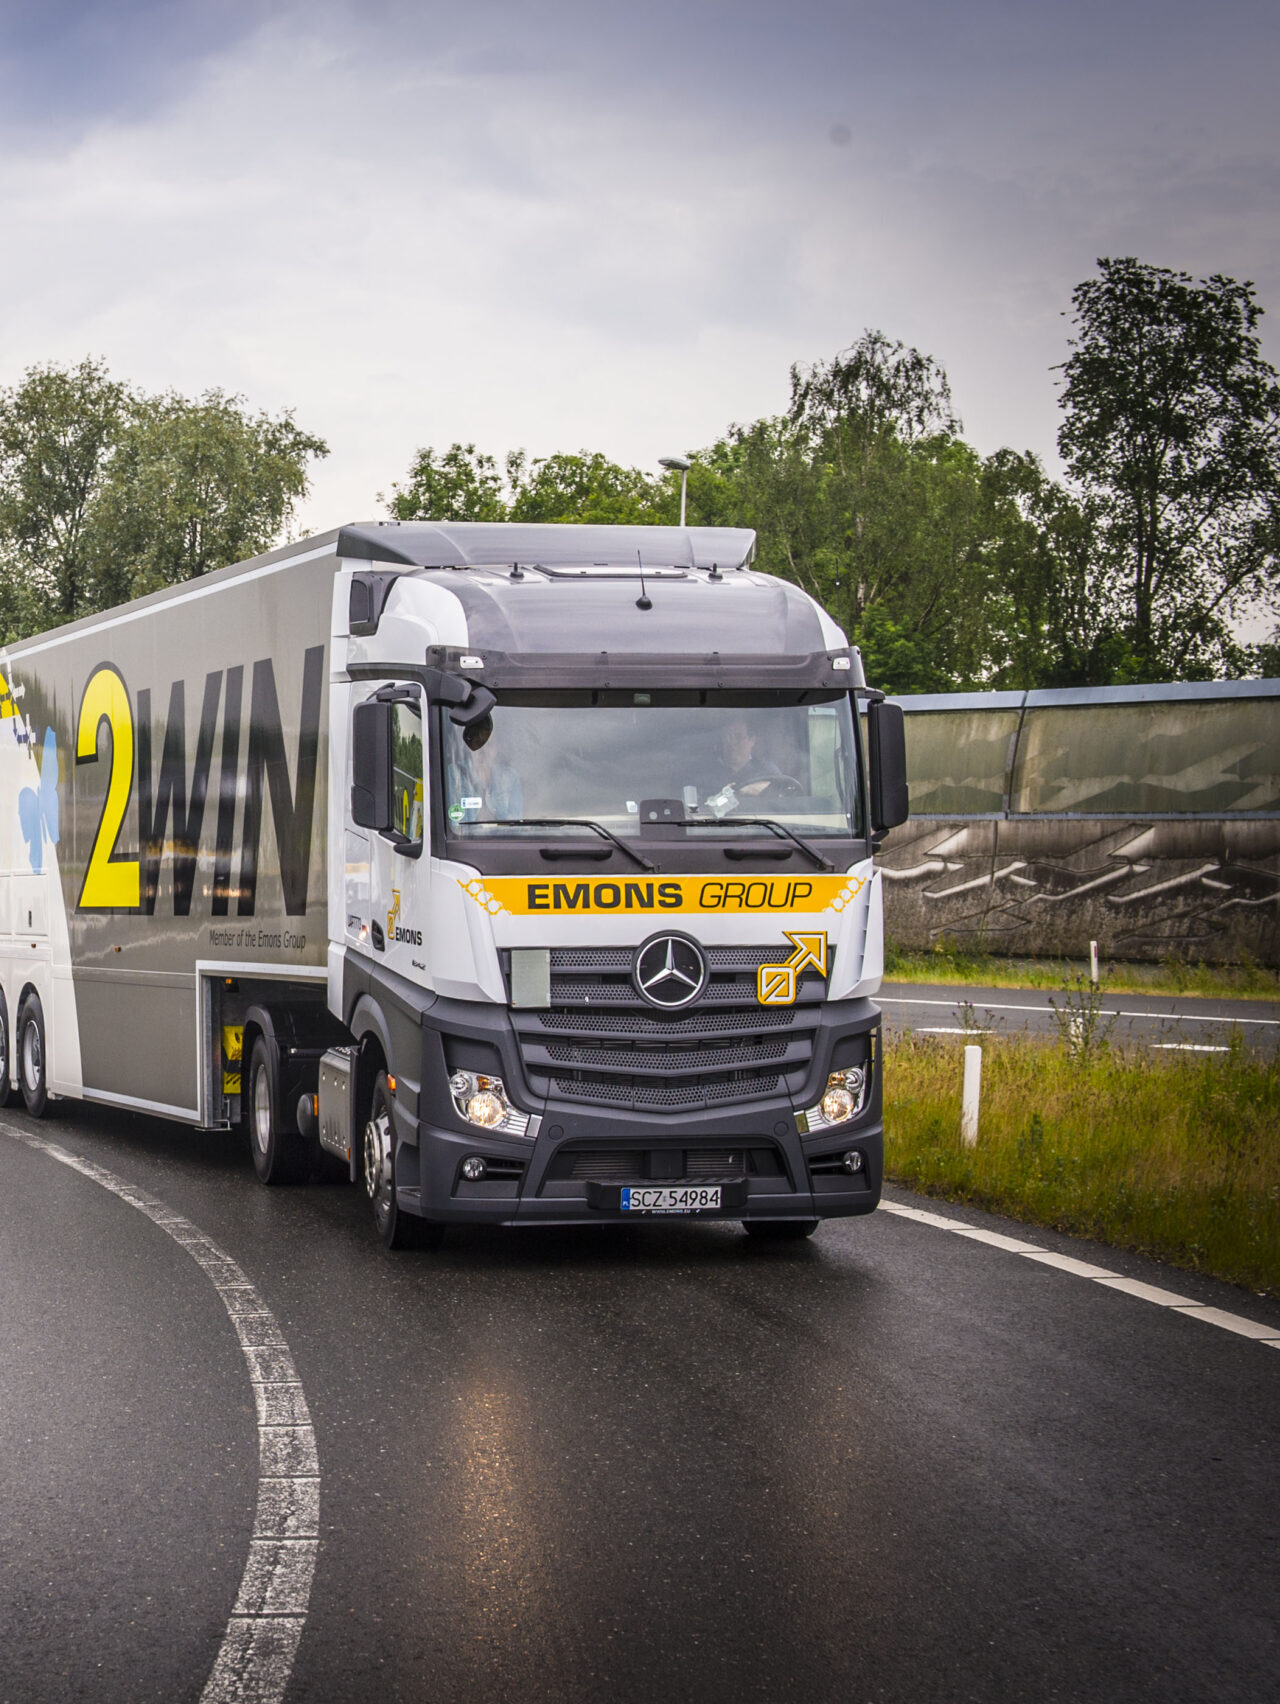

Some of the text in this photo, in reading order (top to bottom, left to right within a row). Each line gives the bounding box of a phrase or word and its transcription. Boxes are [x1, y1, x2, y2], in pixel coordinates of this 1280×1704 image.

[74, 644, 325, 917] 2WIN
[526, 882, 813, 910] EMONS GROUP
[209, 929, 307, 953] Member of the Emons Group
[395, 926, 423, 946] EMONS
[631, 1189, 720, 1207] SCZ 54984
